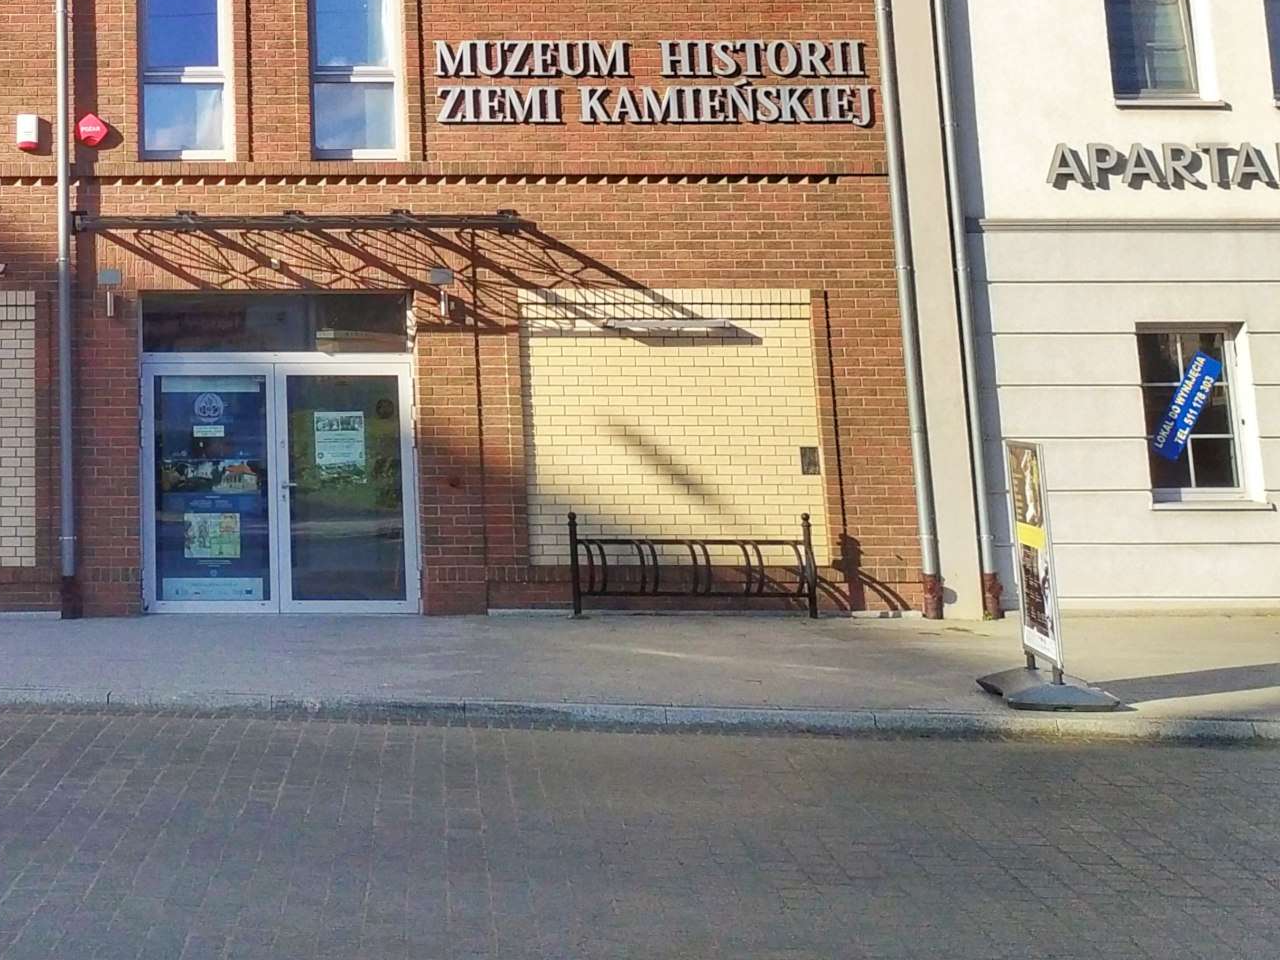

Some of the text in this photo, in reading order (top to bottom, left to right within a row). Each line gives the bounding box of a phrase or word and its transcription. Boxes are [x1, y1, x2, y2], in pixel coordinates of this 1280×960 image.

[434, 39, 867, 77] MUZEUM HISTORII
[437, 78, 873, 126] ZIEMI KAMIEŃSKIEJ
[1046, 142, 1280, 187] APARTA
[1154, 356, 1207, 449] LOKAL DO WYNAJĘCIA
[1183, 408, 1199, 426] 511
[1201, 375, 1215, 392] 303
